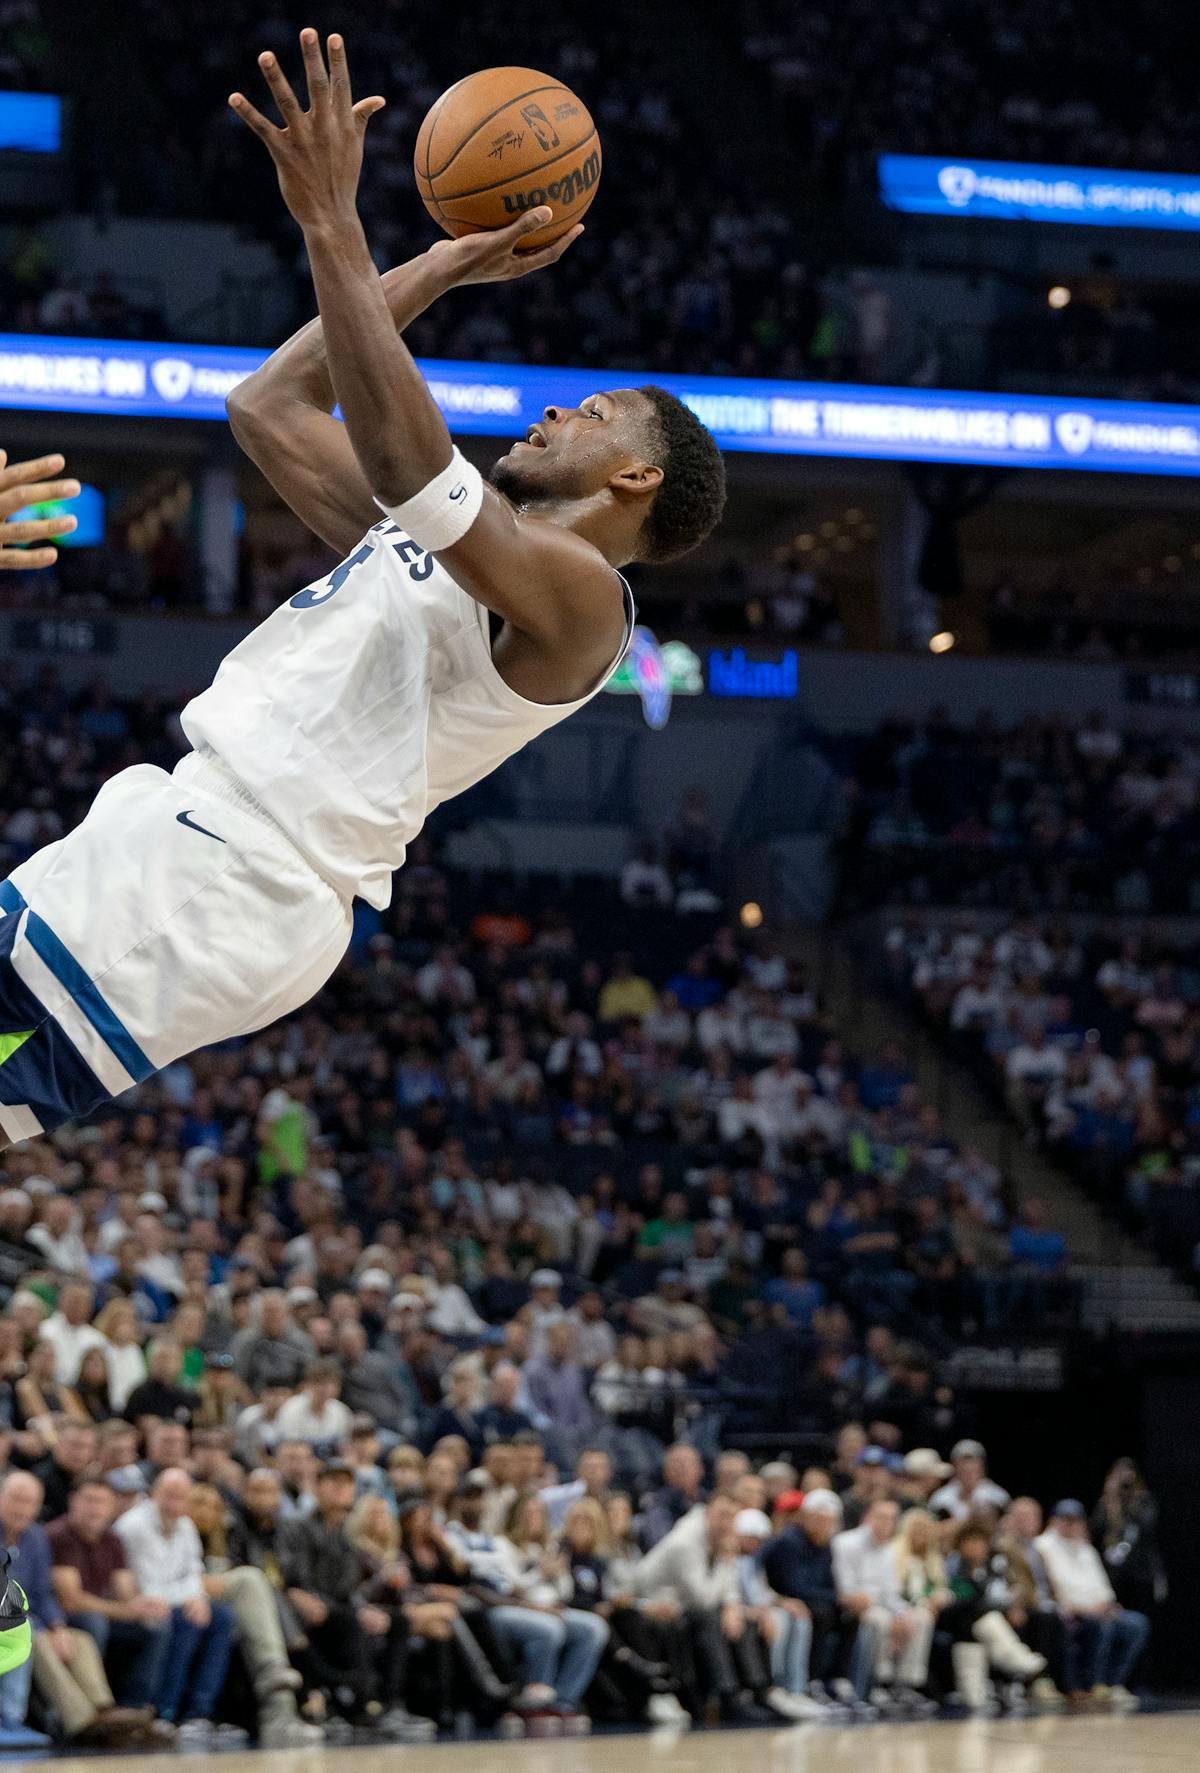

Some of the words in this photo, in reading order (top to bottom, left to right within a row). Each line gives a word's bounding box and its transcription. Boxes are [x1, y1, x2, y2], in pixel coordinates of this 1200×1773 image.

[502, 150, 600, 214] Wilson
[103, 357, 147, 398] ON
[770, 398, 819, 437] THE
[823, 402, 1009, 448] TIMBERWOLVES
[1011, 411, 1050, 450] ON
